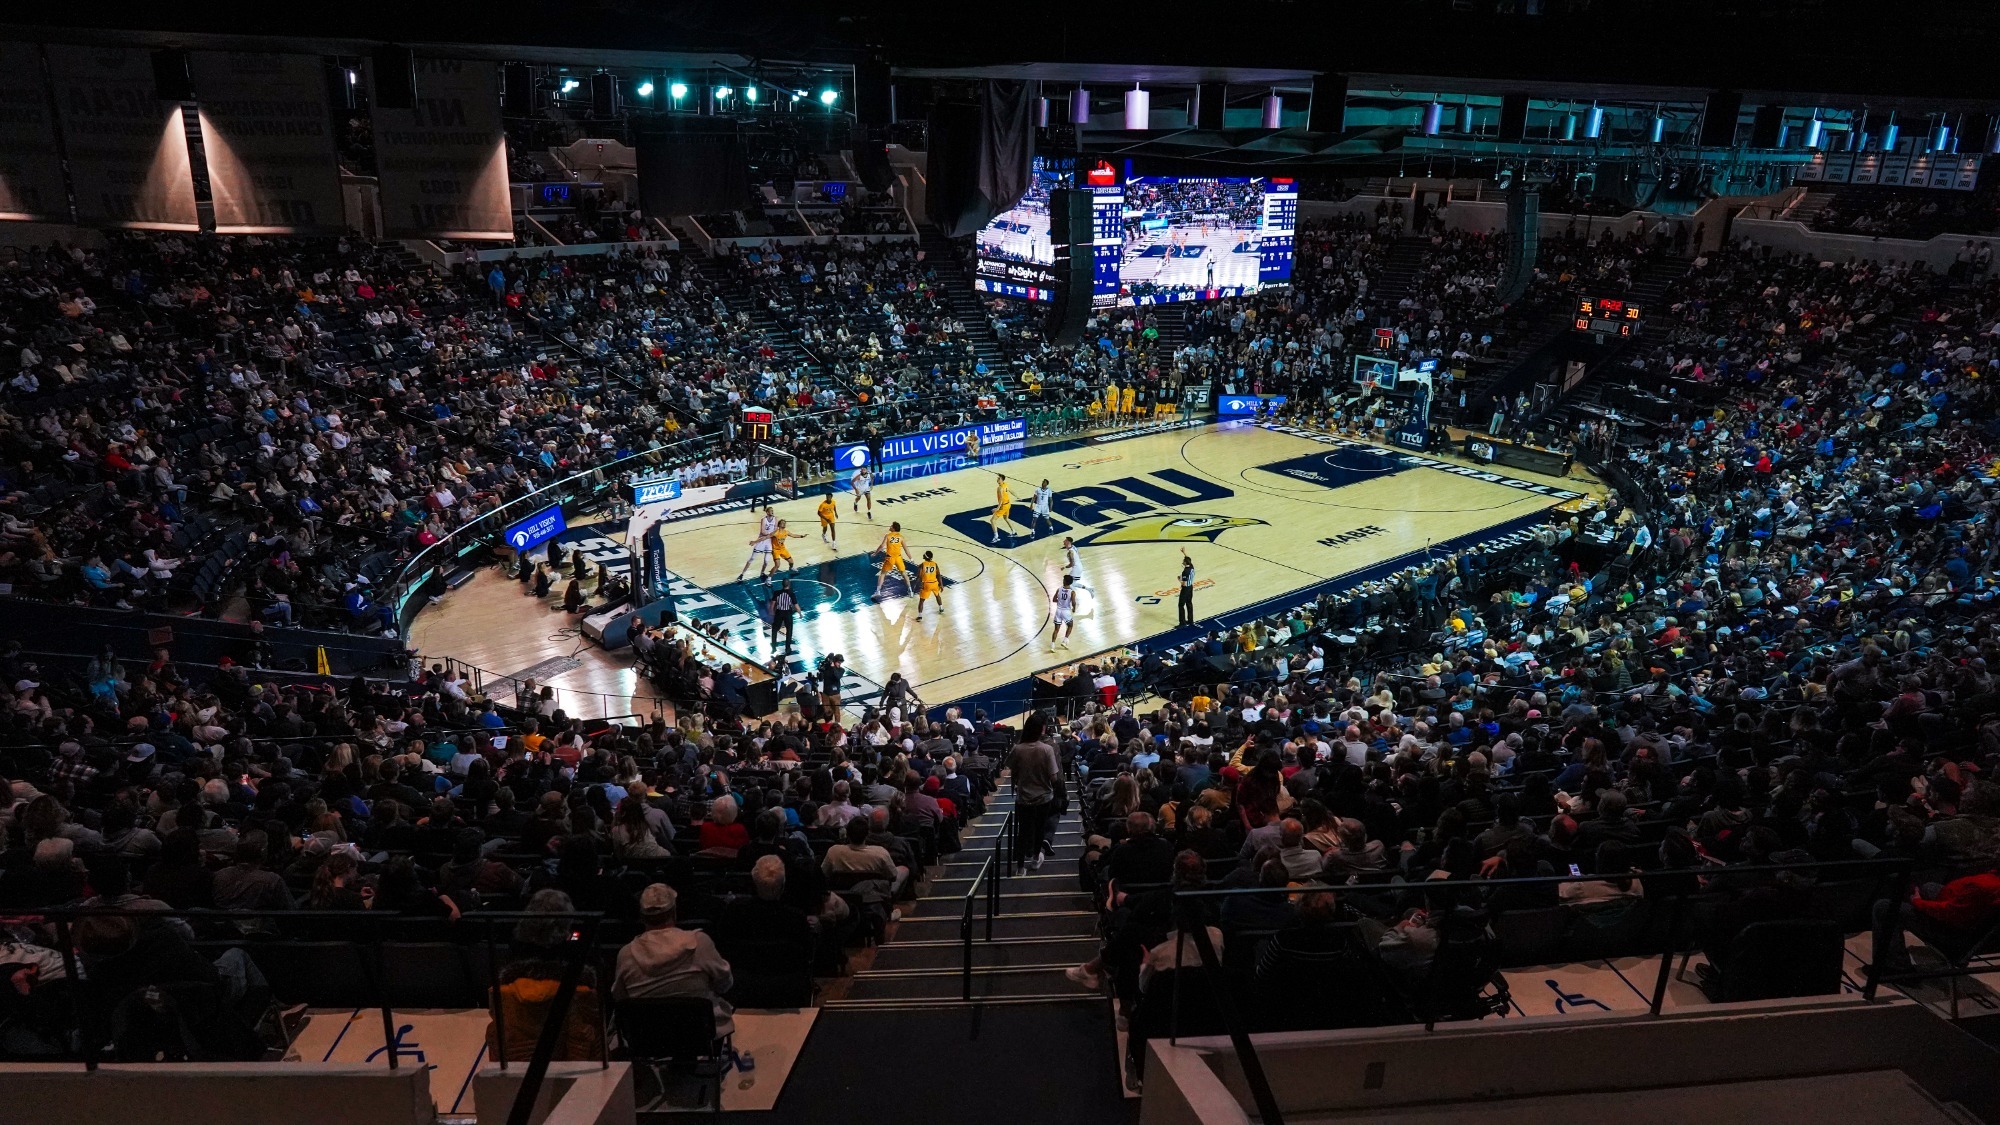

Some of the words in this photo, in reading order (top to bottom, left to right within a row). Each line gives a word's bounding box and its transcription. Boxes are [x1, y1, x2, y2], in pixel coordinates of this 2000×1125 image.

[1178, 291, 1196, 301] 19:23
[1581, 302, 1592, 312] 36
[1626, 308, 1639, 319] 30
[747, 411, 770, 423] 19:22
[753, 424, 768, 439] 17
[1402, 432, 1423, 443] TTCU
[882, 440, 918, 458] HILL
[1399, 456, 1583, 500] MIRACLE
[876, 486, 957, 506] MABEE
[942, 468, 1235, 549] ORU
[528, 523, 540, 535] HILL
[539, 515, 556, 528] VISION
[889, 536, 900, 544] 23
[1316, 524, 1387, 547] MABEE
